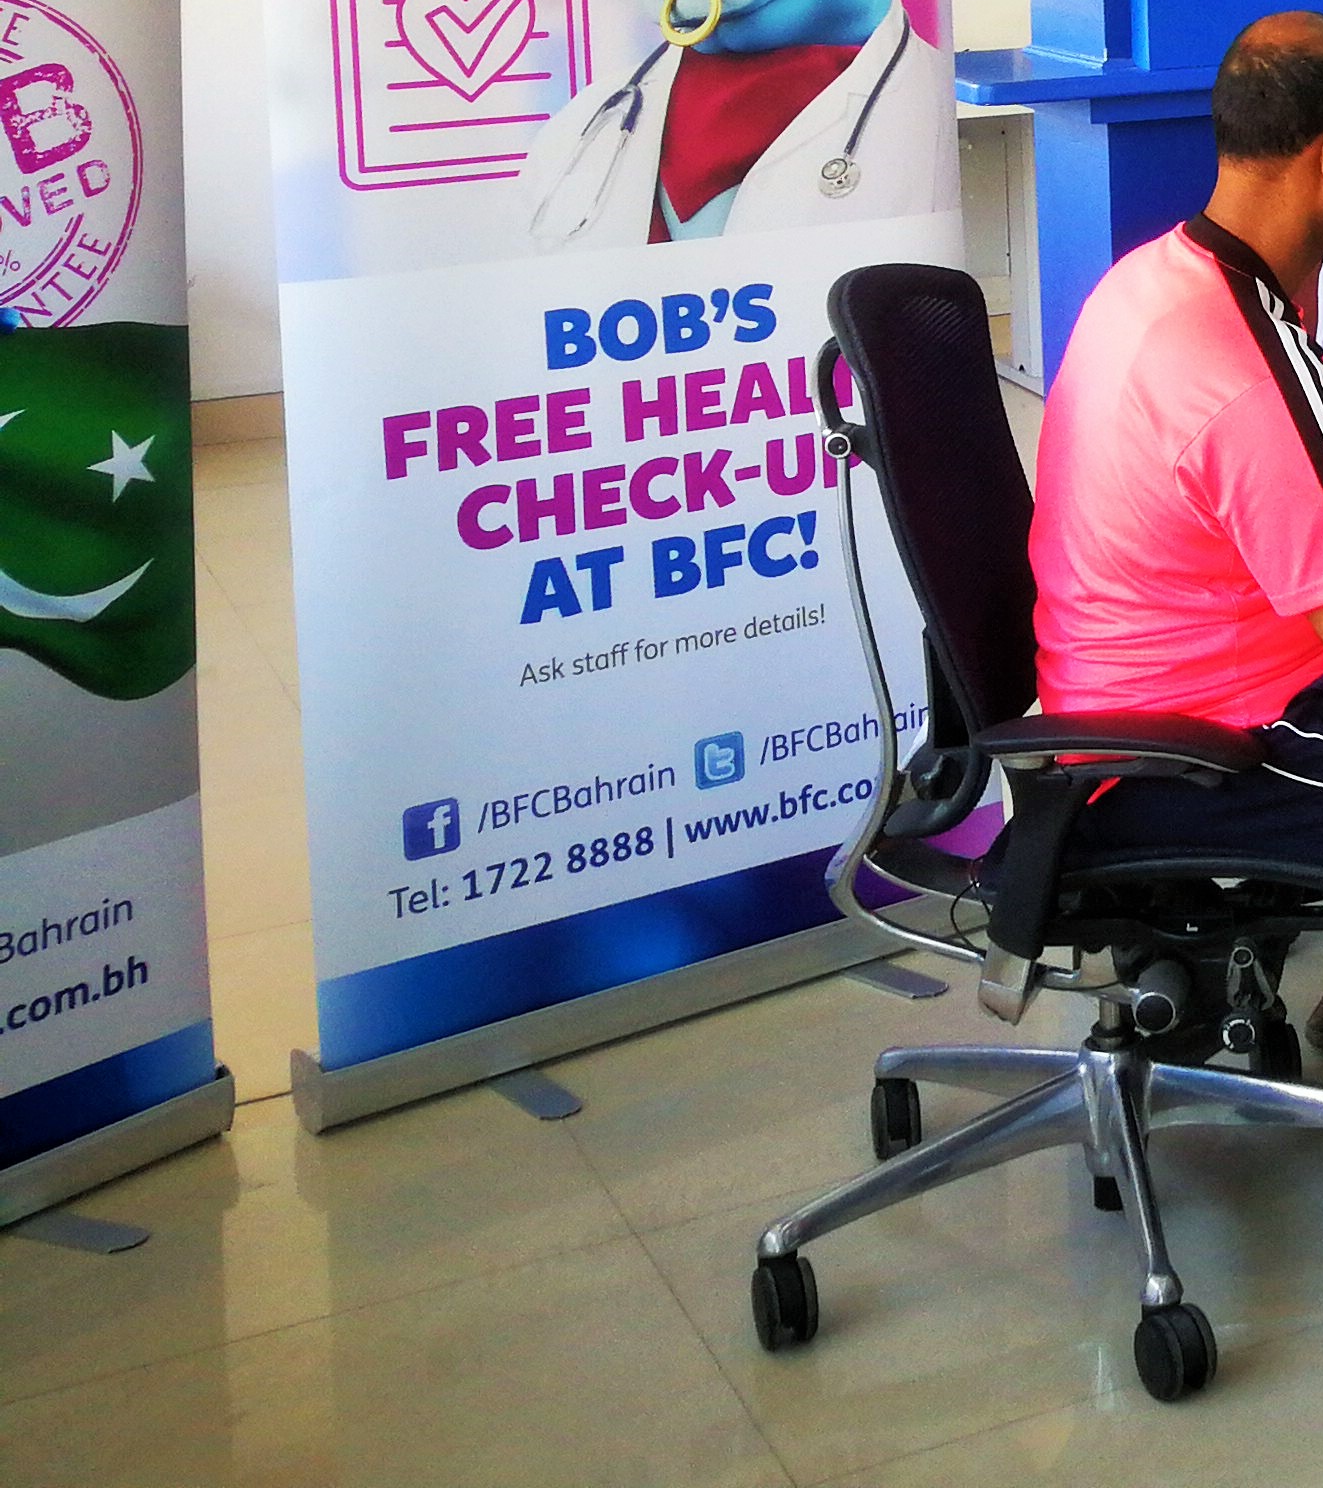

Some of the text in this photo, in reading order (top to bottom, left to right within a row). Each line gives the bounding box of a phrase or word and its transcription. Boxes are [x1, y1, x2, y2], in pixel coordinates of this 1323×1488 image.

[543, 283, 778, 371] BOB'S
[382, 388, 592, 480] FREE
[456, 432, 863, 551] CHECK-UP
[519, 510, 820, 626] AT BFC!
[519, 603, 827, 687] Ask staff for more details!
[477, 702, 928, 835] /BFCBahrain /BFCBahai
[388, 882, 452, 920] Tel:
[462, 853, 553, 901] 1722
[566, 826, 656, 874] 8888
